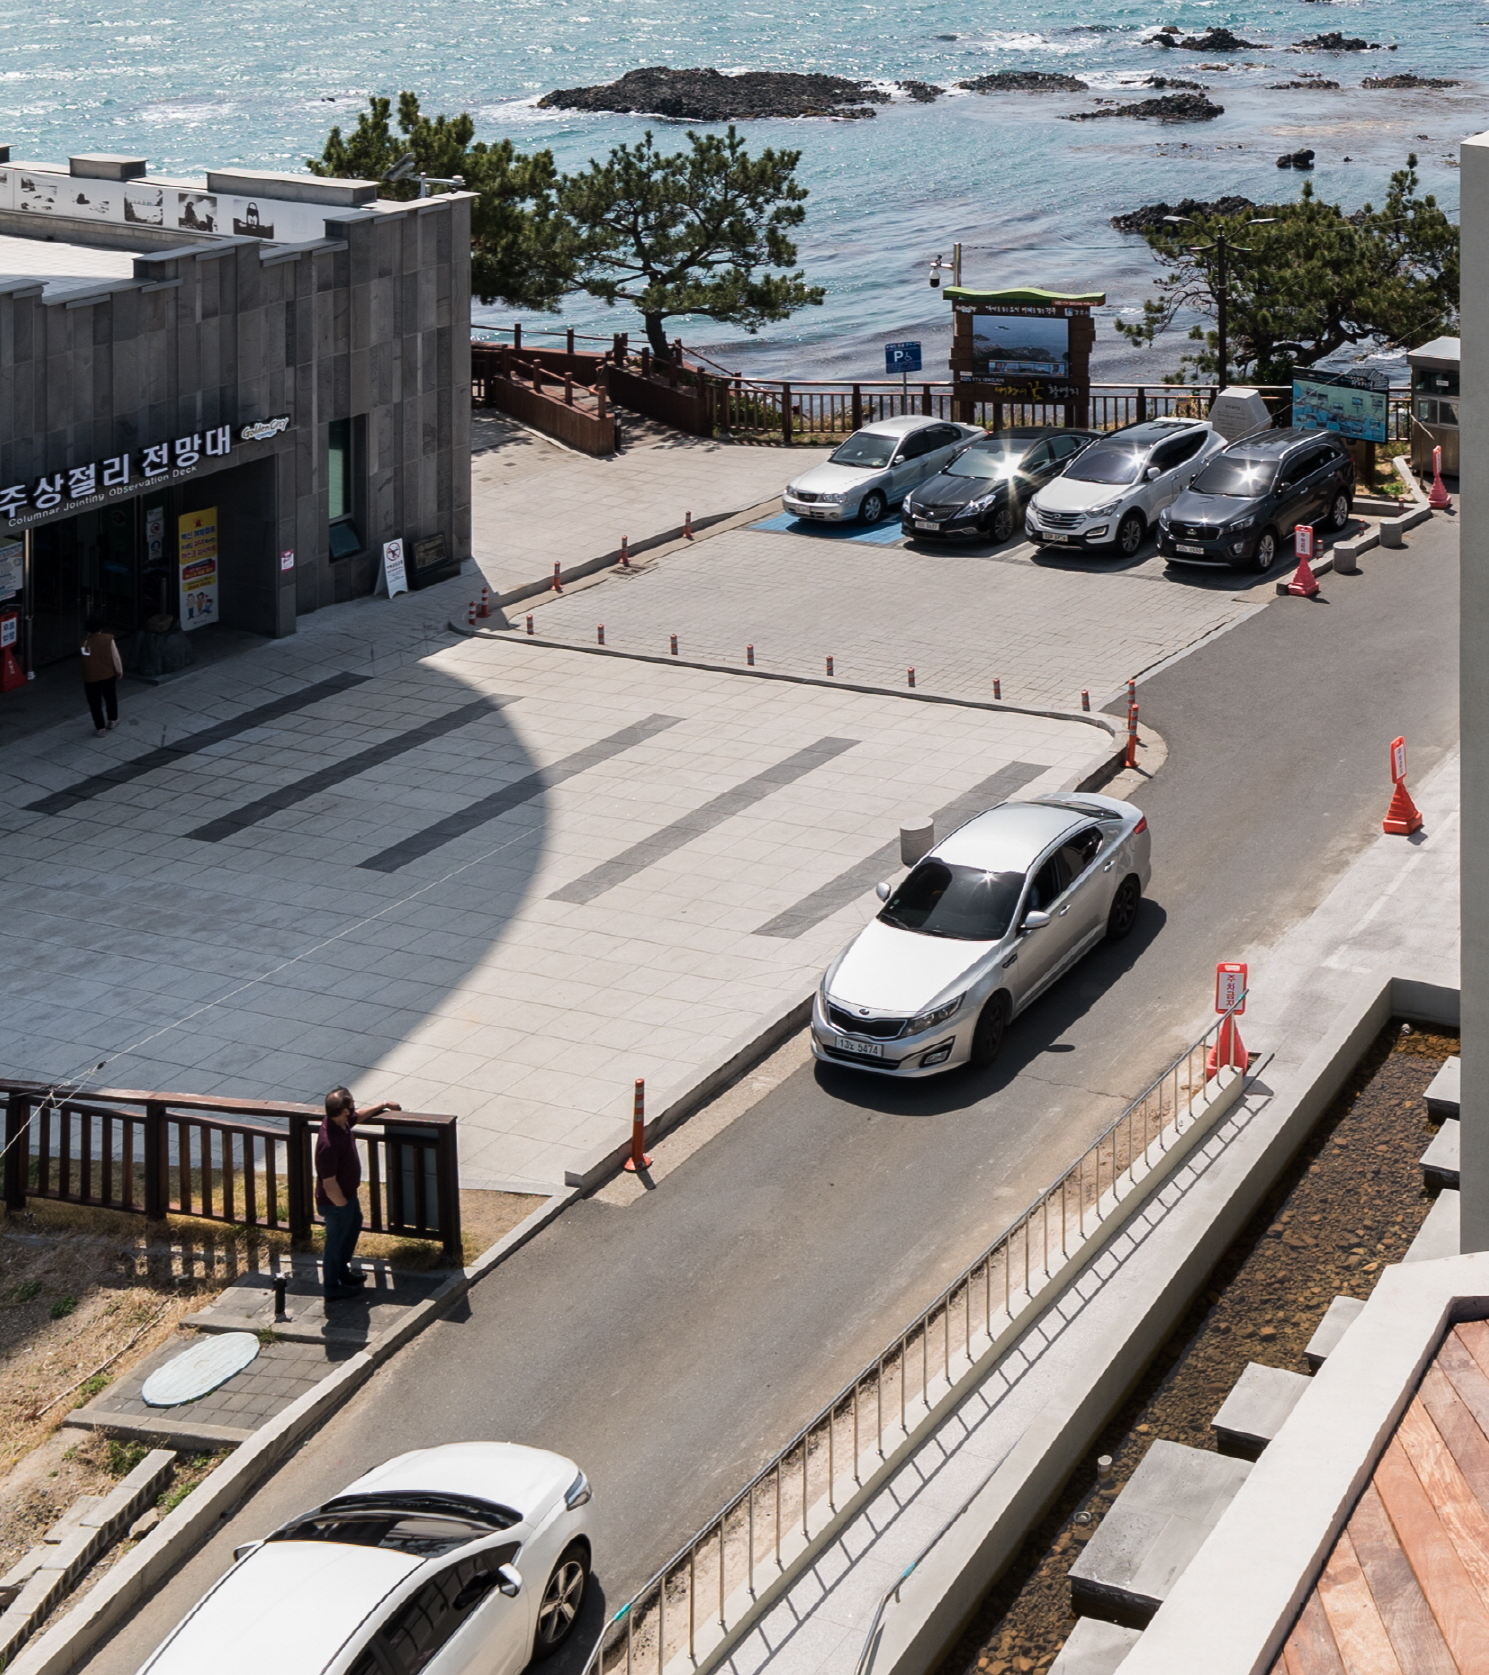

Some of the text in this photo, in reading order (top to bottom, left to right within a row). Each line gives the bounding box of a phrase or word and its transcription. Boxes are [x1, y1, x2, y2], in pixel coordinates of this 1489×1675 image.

[894, 350, 904, 363] P
[141, 425, 231, 476] 전망대
[8, 464, 198, 527] Columnar Jointing Observation Deck
[857, 1043, 878, 1055] 5474
